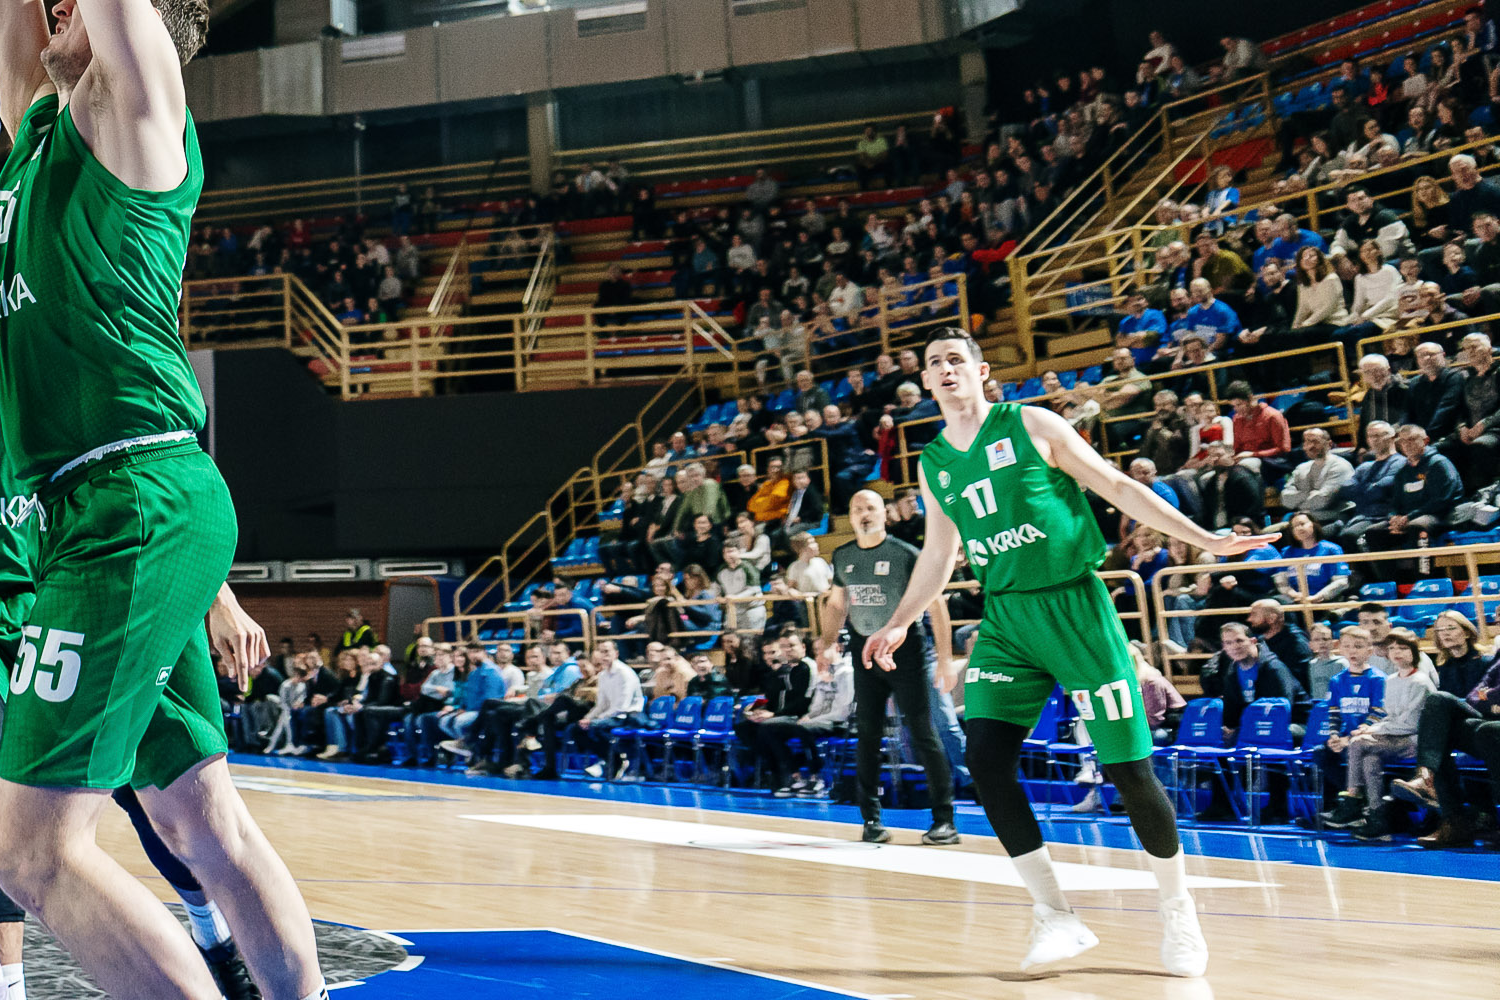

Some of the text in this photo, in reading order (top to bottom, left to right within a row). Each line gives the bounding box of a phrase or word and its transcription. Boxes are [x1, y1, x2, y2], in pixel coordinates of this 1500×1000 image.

[960, 477, 998, 519] 17
[986, 523, 1047, 555] KRKA
[10, 624, 85, 703] 55
[1094, 679, 1134, 721] 17
